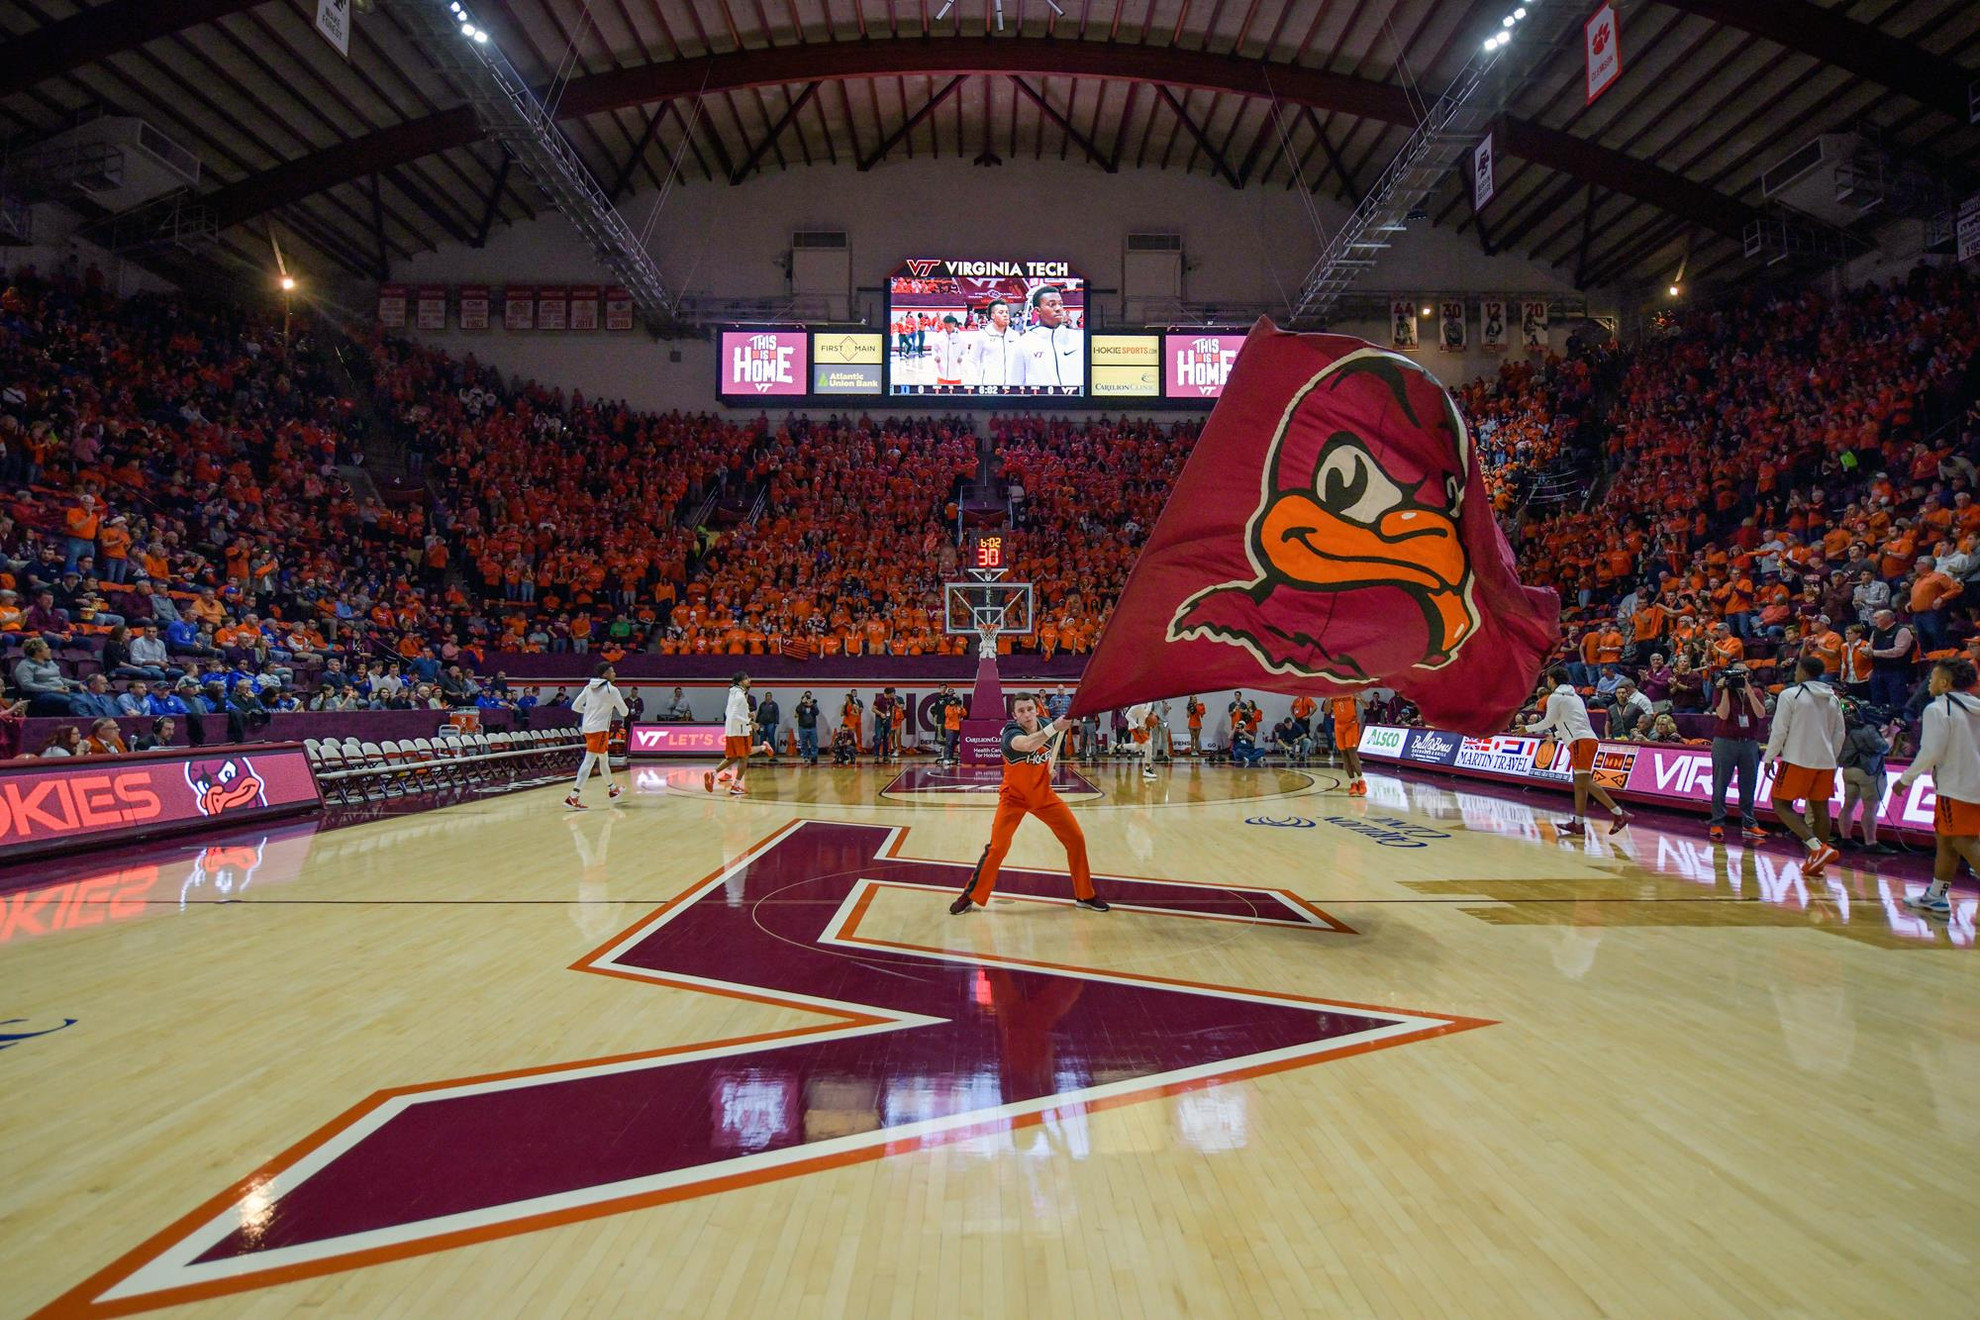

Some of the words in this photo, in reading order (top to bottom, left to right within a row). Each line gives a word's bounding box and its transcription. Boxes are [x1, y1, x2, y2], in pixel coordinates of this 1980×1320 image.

[1591, 55, 1614, 82] CLEMSON
[906, 259, 942, 277] VT
[944, 261, 1024, 277] VIRGINIA
[1027, 262, 1069, 277] TECH
[1393, 302, 1415, 317] 44
[1442, 302, 1462, 319] 30
[1485, 302, 1501, 317] 12
[1525, 302, 1545, 318] 20
[749, 334, 777, 350] THIS
[1192, 338, 1220, 354] THIS
[760, 350, 769, 360] IS
[1203, 354, 1212, 363] IS
[733, 346, 796, 383] HOME
[1177, 349, 1239, 387] HOME
[829, 372, 864, 380] Atlantic
[754, 383, 773, 393] VT
[978, 385, 998, 394] 6:02
[1060, 386, 1078, 394] VT
[1198, 386, 1217, 396] VT
[980, 537, 1001, 548] 6:02
[978, 548, 999, 566] 30
[636, 730, 669, 747] VT
[669, 734, 714, 746] LET'S
[1367, 728, 1400, 748] ALSCO
[1457, 751, 1493, 767] MARTIN
[1494, 754, 1529, 772] TRAVEL
[0, 772, 162, 842] KIES
